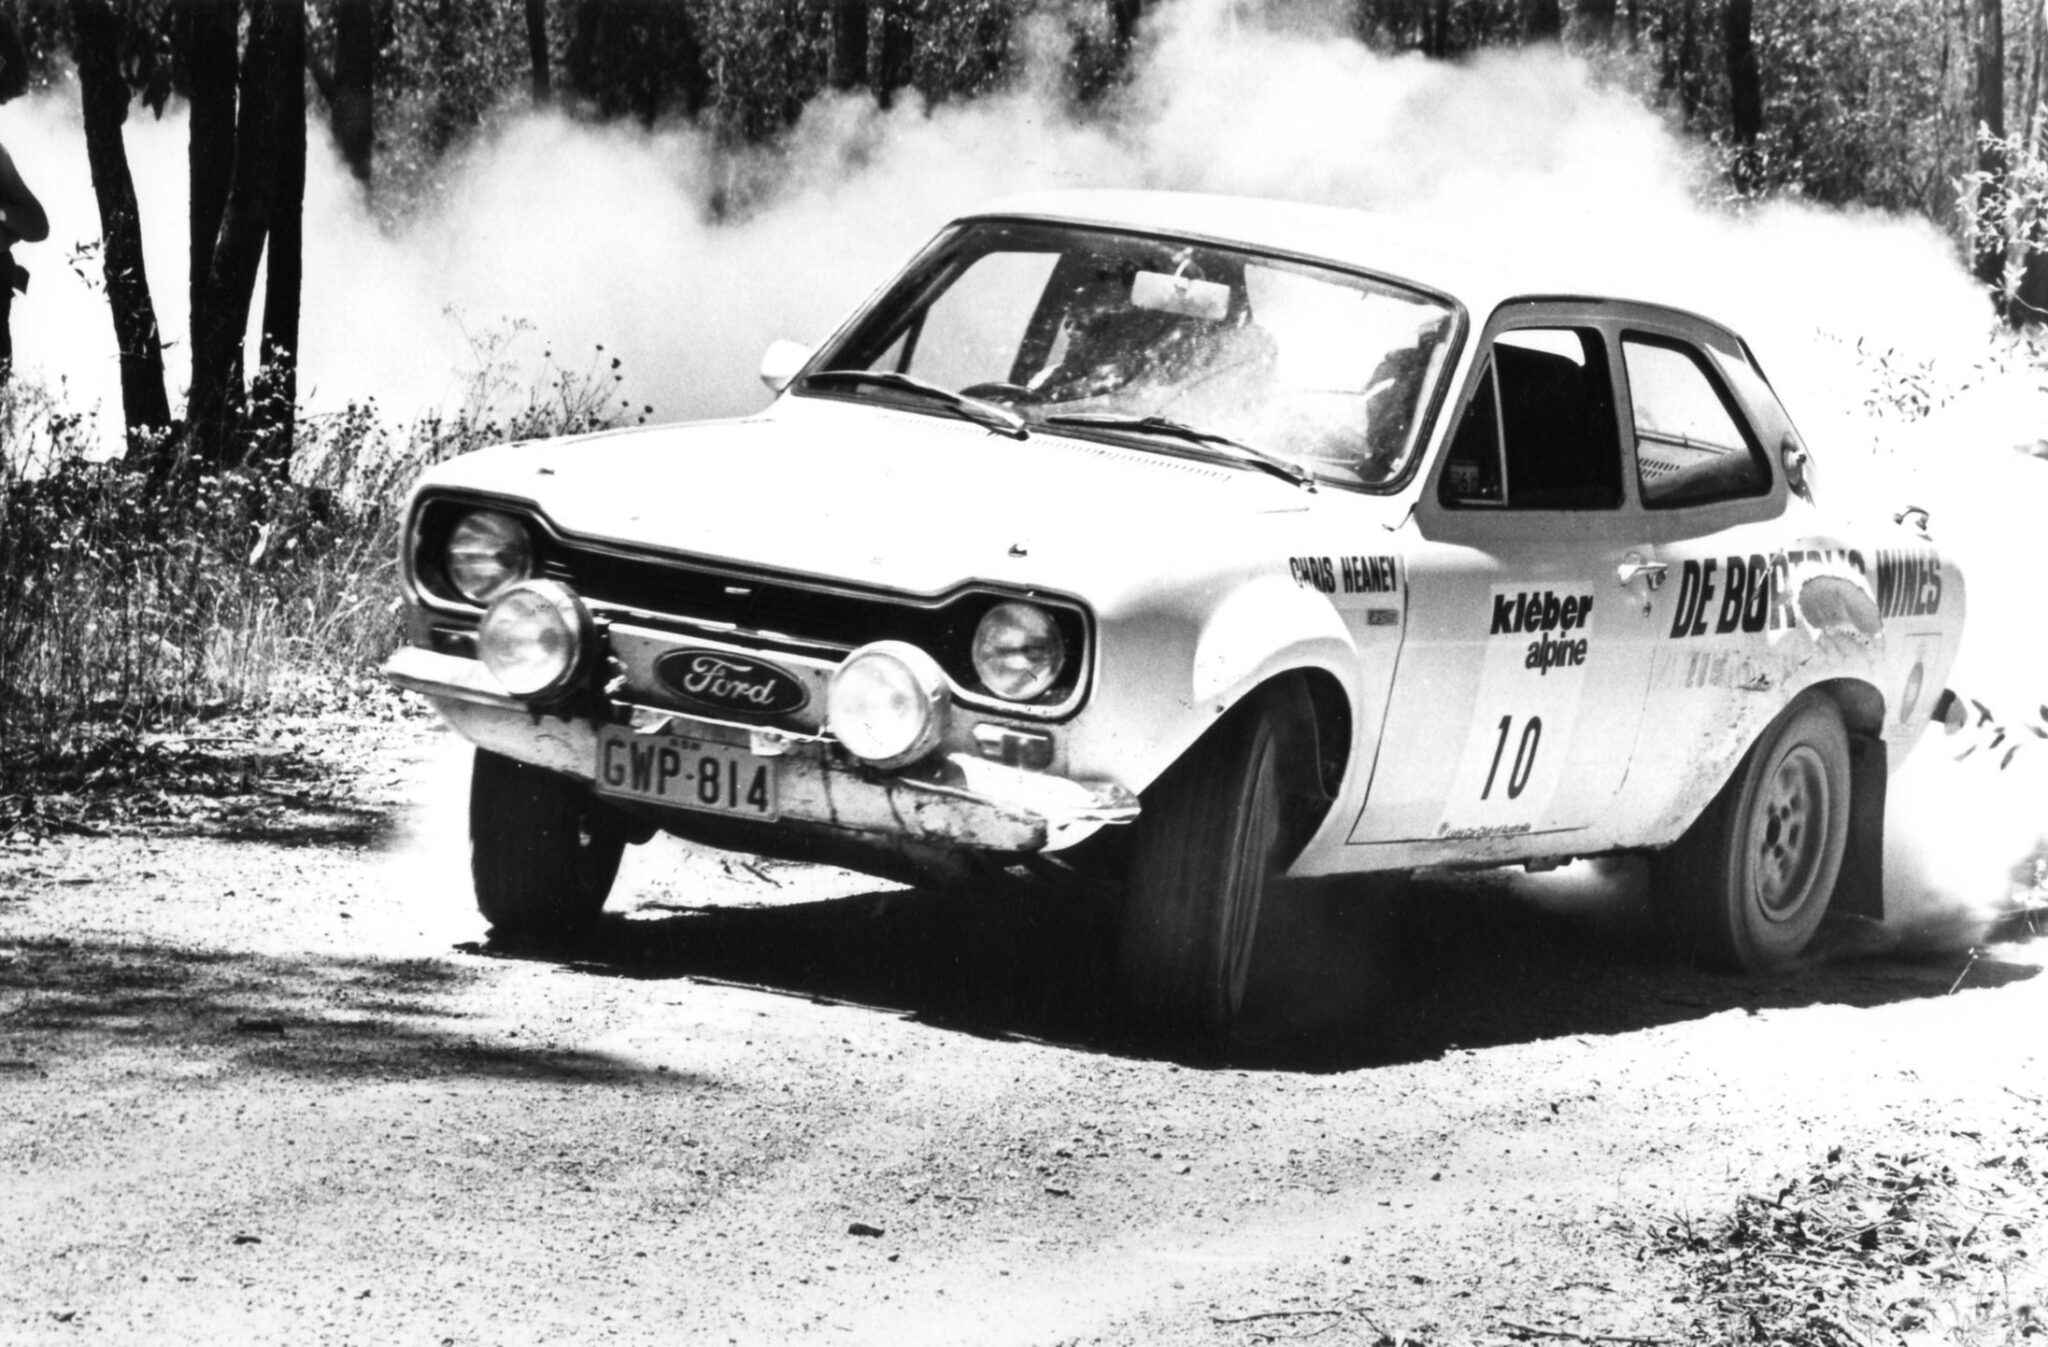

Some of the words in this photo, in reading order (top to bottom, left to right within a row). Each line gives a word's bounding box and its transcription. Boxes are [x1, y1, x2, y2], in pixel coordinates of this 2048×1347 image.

[1289, 556, 1336, 593] CHRIS
[1341, 556, 1396, 593] HEANEY
[1669, 558, 1717, 639] DE
[1875, 549, 1941, 618] WINES
[1490, 590, 1594, 635] kléber
[1524, 631, 1588, 676] alpine
[684, 656, 776, 705] Ford
[602, 738, 769, 813] GWP-814
[1480, 715, 1542, 801] 10
